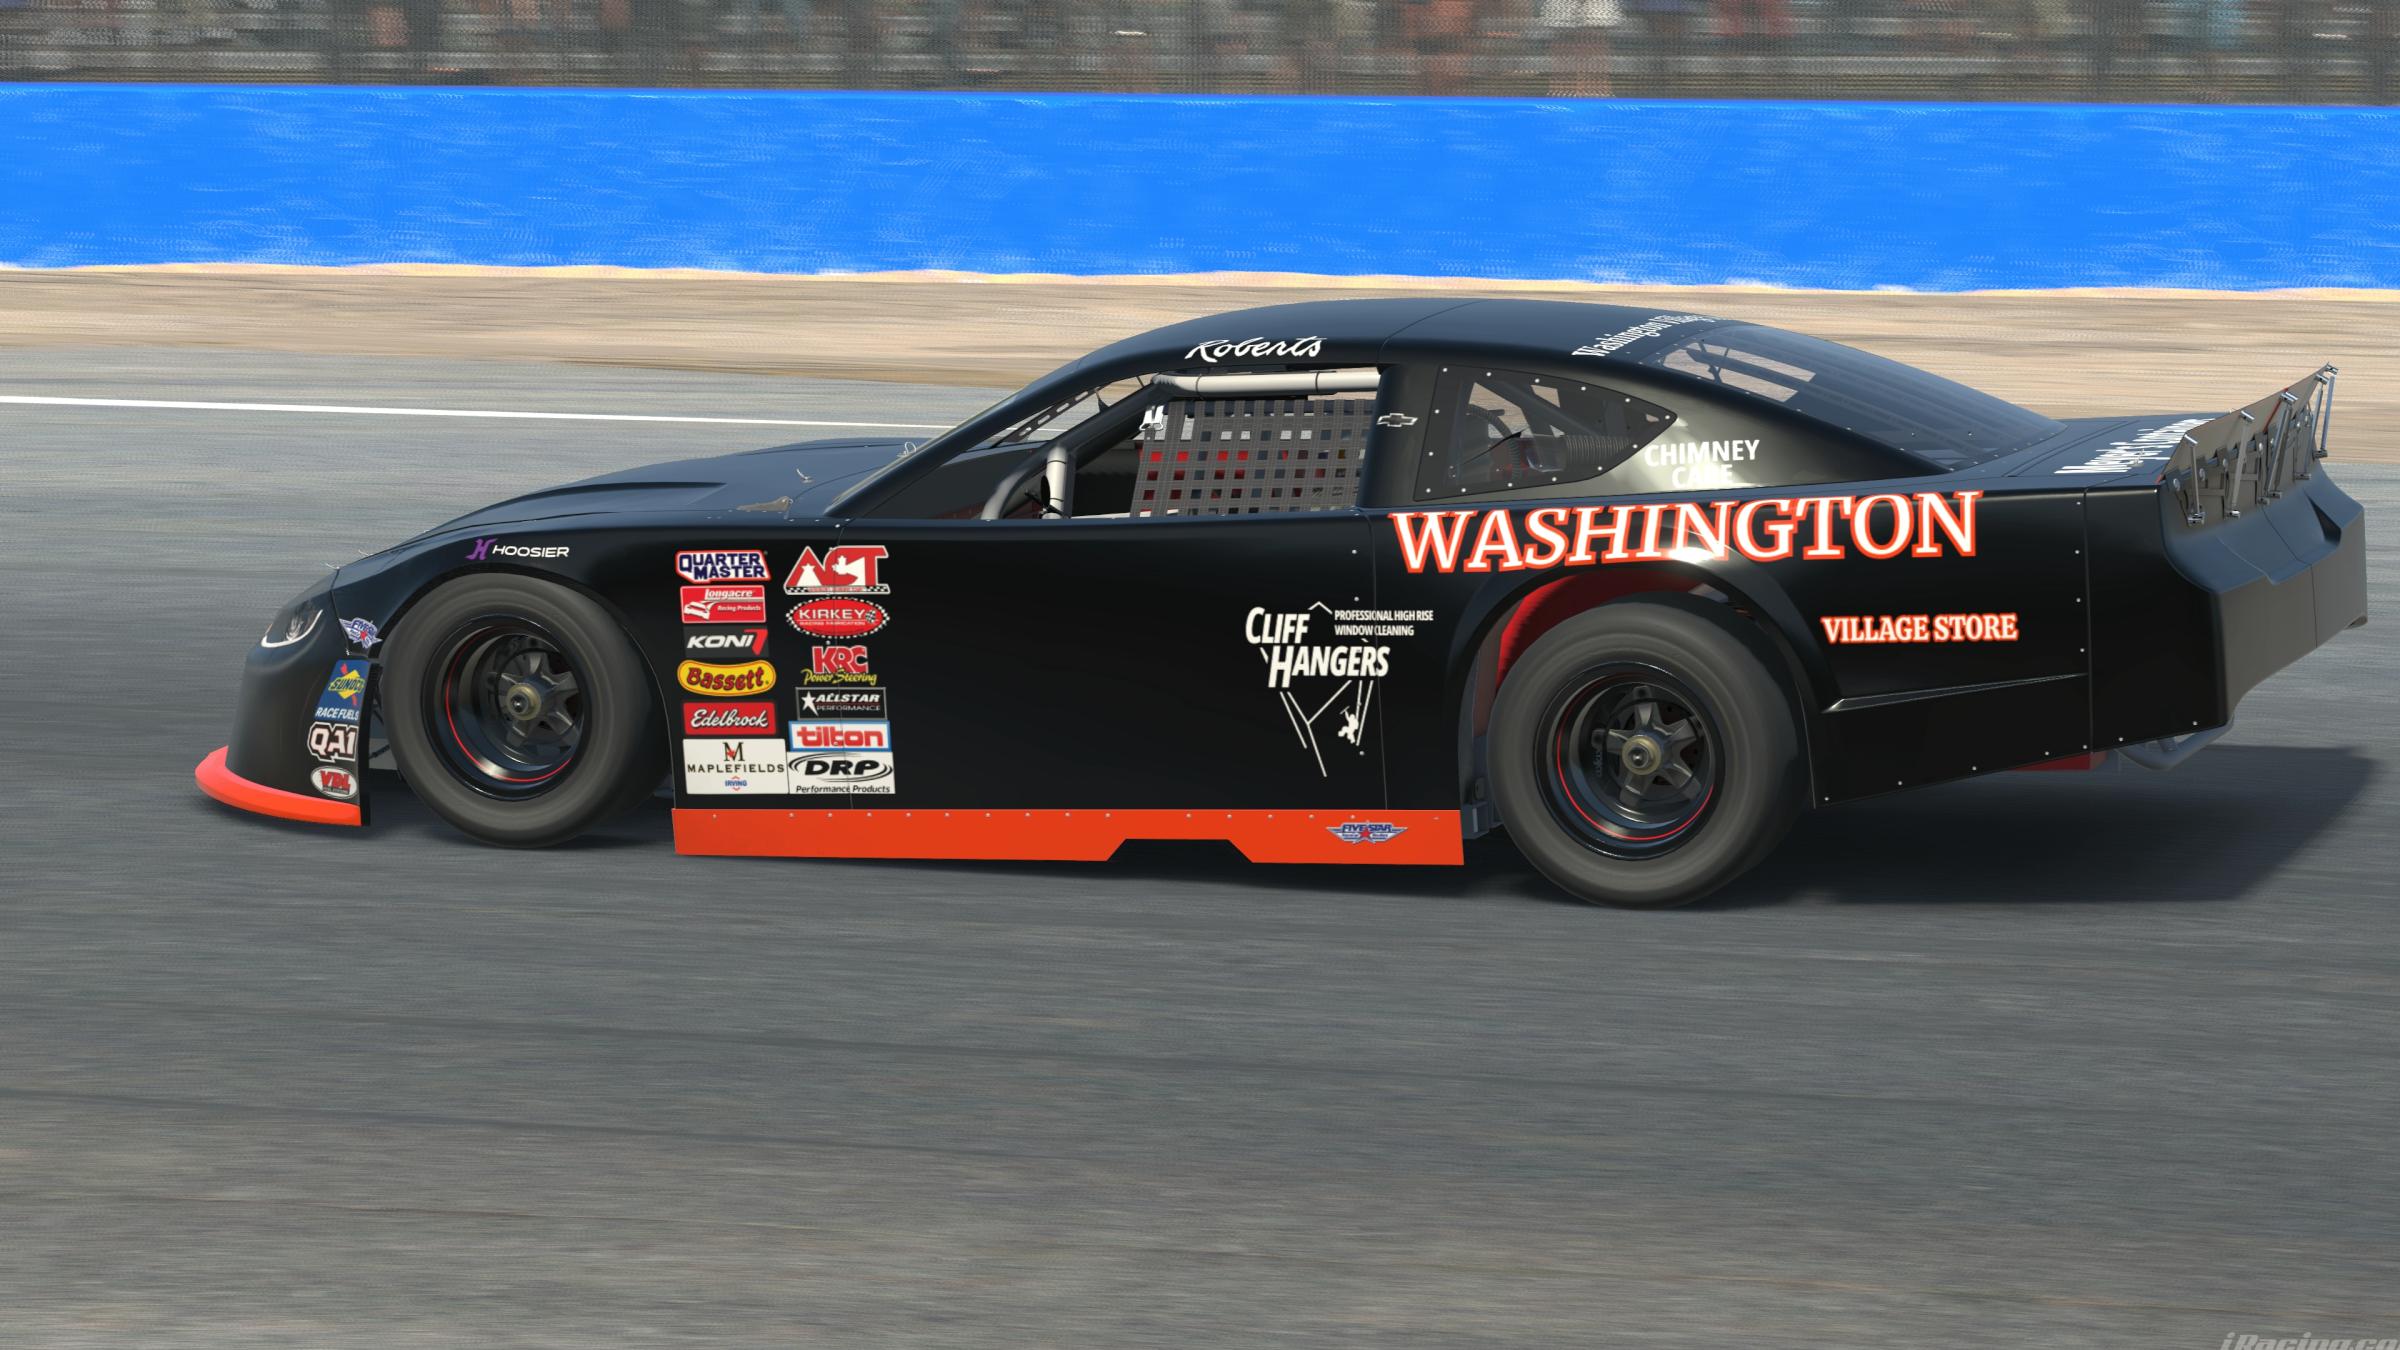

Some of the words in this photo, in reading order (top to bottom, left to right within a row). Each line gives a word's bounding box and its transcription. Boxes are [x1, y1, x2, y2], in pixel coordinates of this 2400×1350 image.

[1185, 336, 1328, 363] Roberts
[1644, 439, 1760, 467] CHIMNEY
[1672, 464, 1733, 488] CAE
[1388, 490, 1983, 573] WASHINGTON
[492, 545, 570, 557] HOOSIER
[679, 553, 760, 572] QUARTER
[694, 564, 765, 580] MASTER
[799, 609, 865, 619] KIRKEY
[1334, 610, 1393, 621] PROFESSIONAL
[1394, 610, 1415, 621] HIGH
[1416, 610, 1434, 621] RISE
[1245, 606, 1310, 644] CLIFF
[1334, 625, 1373, 636] WINDOW
[1374, 625, 1414, 636] CLEANING
[1821, 614, 1931, 644] VILLAGE
[1933, 612, 2020, 643] STORE
[687, 635, 753, 648] KONI
[812, 645, 869, 674] KRC
[1268, 645, 1391, 688] HANGERS
[686, 667, 764, 690] Bassett
[801, 668, 833, 686] Power
[816, 693, 880, 702] ALLSTAR
[315, 707, 339, 719] RACE
[338, 709, 360, 720] FUELS
[691, 709, 768, 728] Edelbrock
[310, 727, 356, 756] QA1
[796, 726, 884, 747] tilton
[687, 764, 785, 773] MAPLEFIELDS
[804, 760, 880, 775] DRP
[796, 785, 850, 793] Performance
[852, 785, 890, 793] Products
